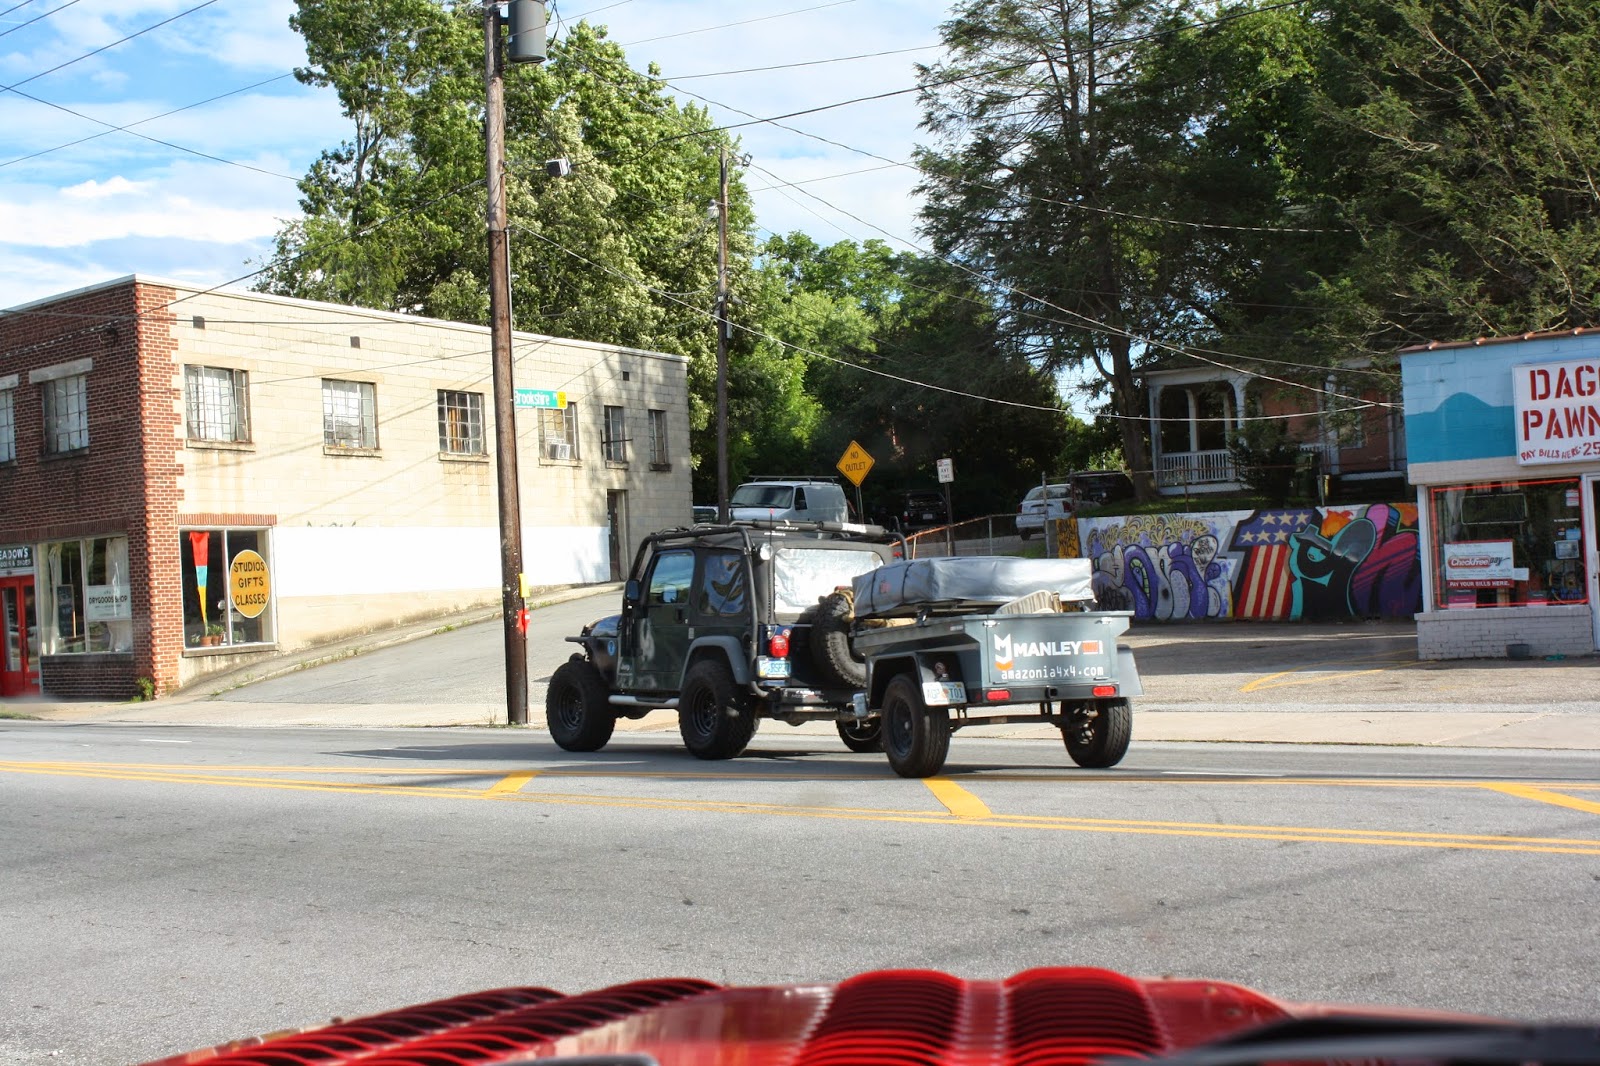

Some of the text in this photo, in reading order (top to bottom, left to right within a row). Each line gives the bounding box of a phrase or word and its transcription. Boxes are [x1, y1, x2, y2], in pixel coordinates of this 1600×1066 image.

[1530, 365, 1600, 400] DAG
[1523, 405, 1600, 441] PAWN
[850, 451, 858, 459] NO
[1521, 449, 1536, 461] PAY
[1539, 449, 1559, 459] BILLS
[845, 461, 866, 472] OUTLET
[233, 561, 265, 573] STUDIOS
[238, 576, 264, 588] GIFTS
[235, 593, 266, 606] CLASSES
[1013, 640, 1082, 658] MANLEY
[1001, 666, 1105, 680] amazonia4x4.com
